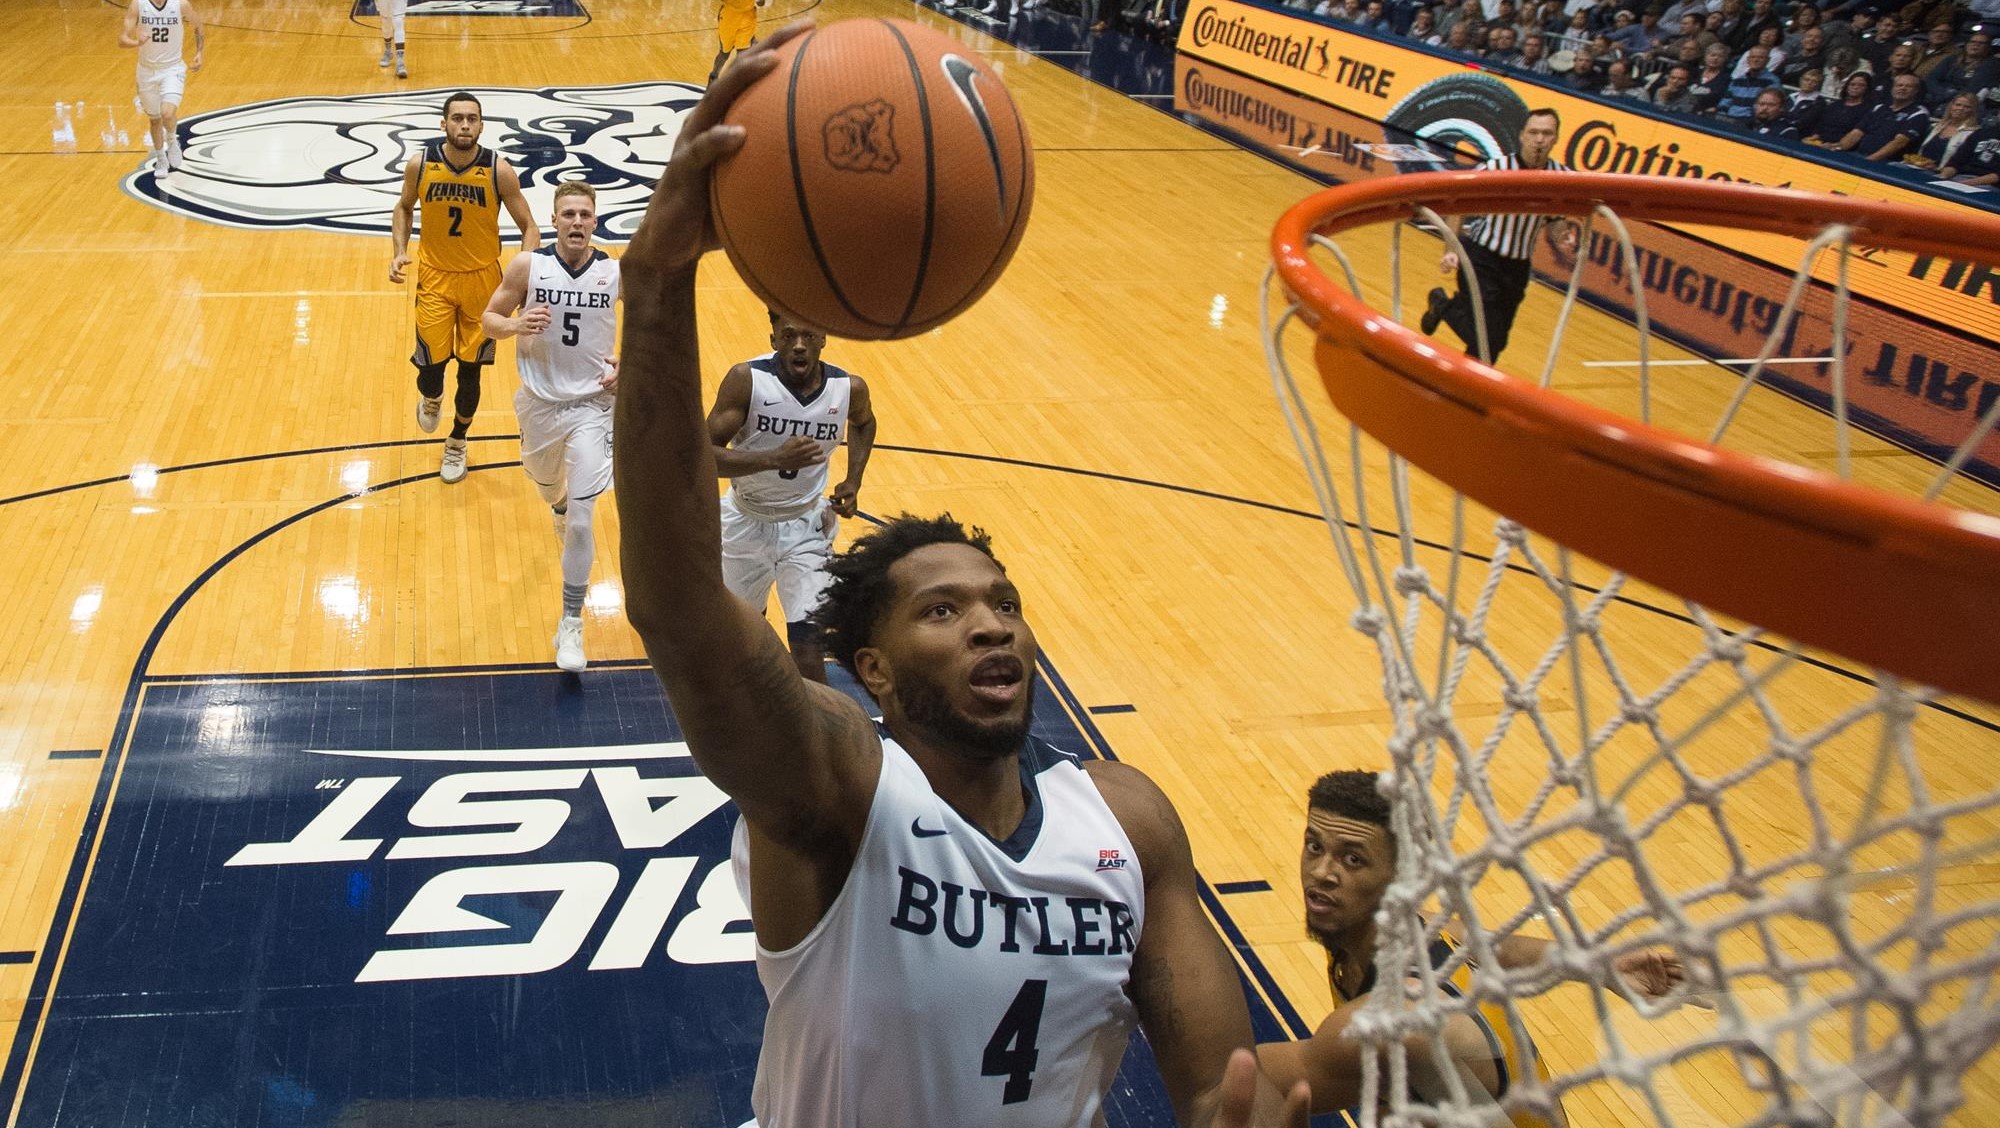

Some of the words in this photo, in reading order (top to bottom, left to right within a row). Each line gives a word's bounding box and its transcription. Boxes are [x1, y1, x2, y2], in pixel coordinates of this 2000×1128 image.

[141, 16, 178, 25] BUTLER
[152, 27, 169, 43] 22
[1193, 6, 1313, 72] Continental
[1336, 56, 1395, 99] TIRE
[425, 182, 487, 208] KENNESAW
[448, 205, 463, 237] 2
[535, 288, 611, 308] BUTLER
[562, 312, 581, 346] 5
[756, 414, 839, 441] BUTLER
[223, 767, 732, 866] AST
[1098, 859, 1127, 868] EAST
[1100, 850, 1119, 858] BIG
[890, 865, 1136, 956] BUTLER
[980, 978, 1048, 1105] 4
